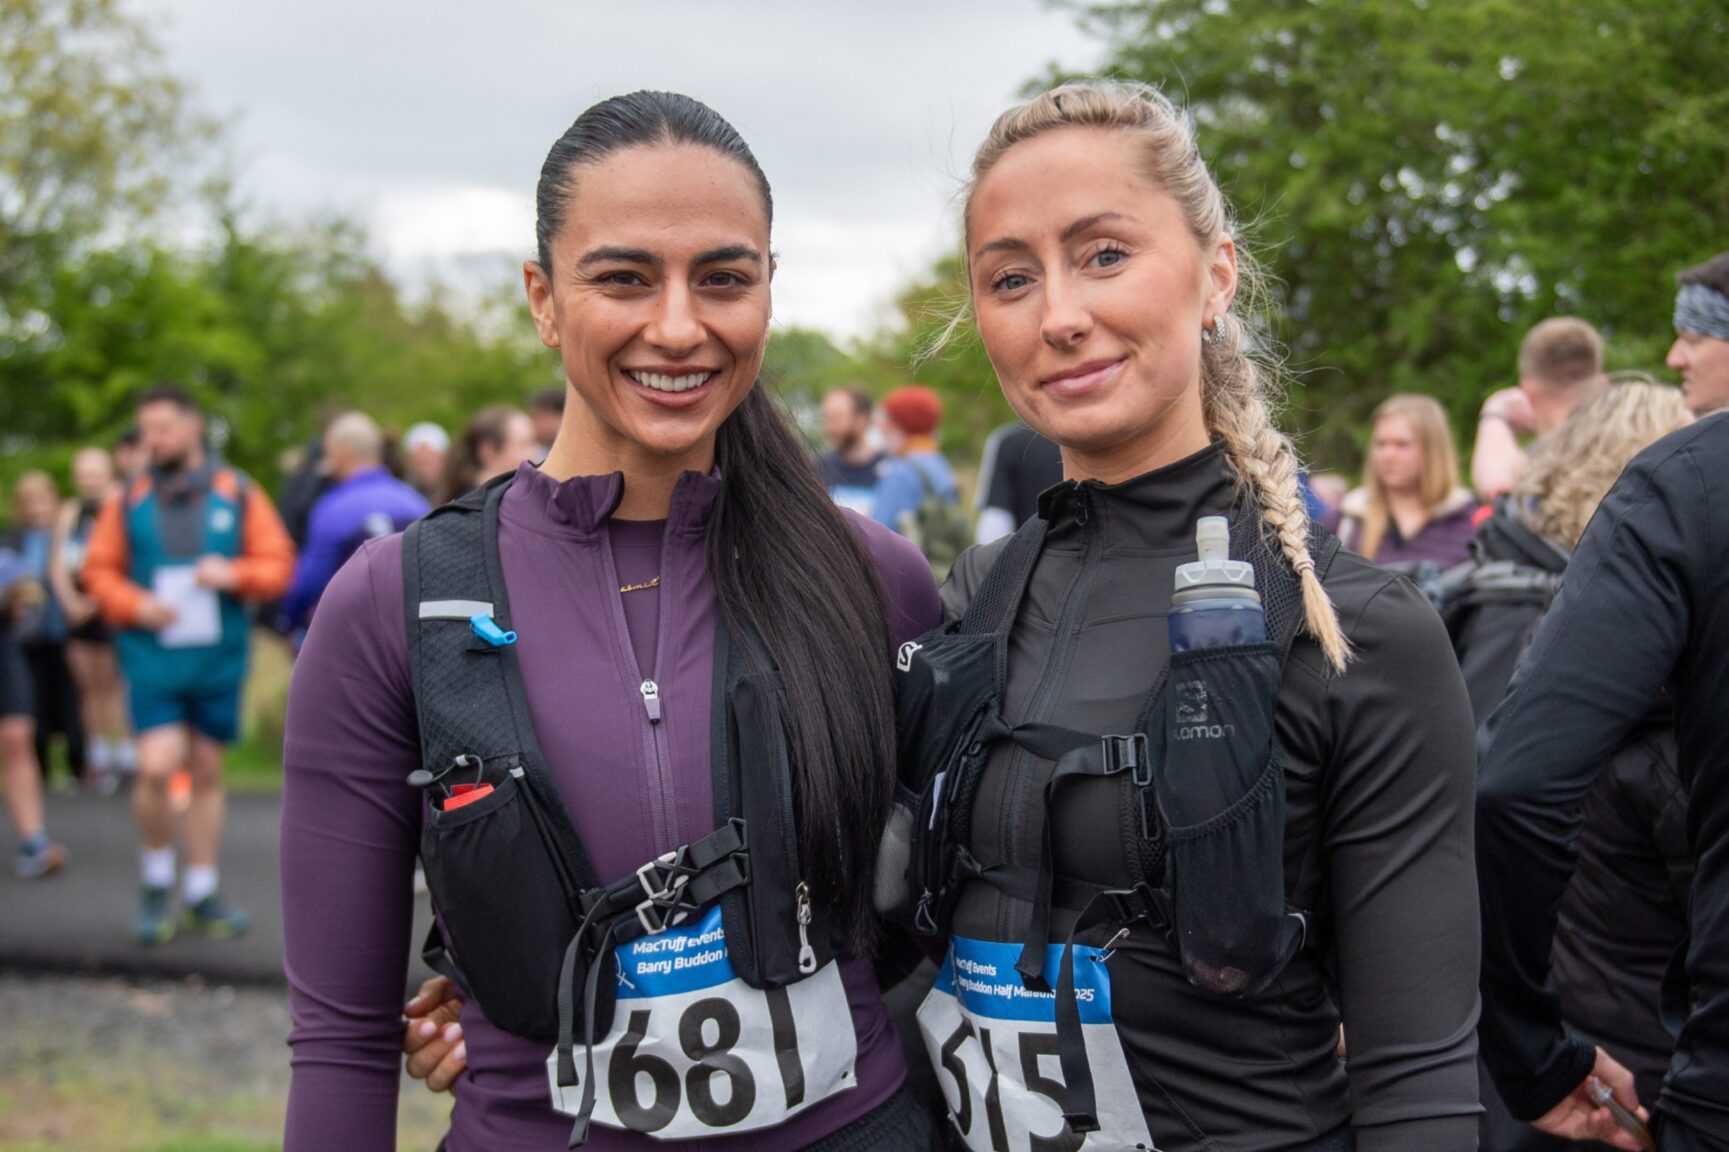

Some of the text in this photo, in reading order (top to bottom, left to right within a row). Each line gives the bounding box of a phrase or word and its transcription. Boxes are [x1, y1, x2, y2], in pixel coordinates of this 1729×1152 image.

[633, 936, 688, 955] MacTuff
[637, 959, 672, 975] Barry
[674, 949, 723, 970] Buddon
[972, 962, 997, 976] Events
[993, 984, 1013, 999] Half
[1074, 988, 1095, 1002] 025
[608, 997, 805, 1133] 681
